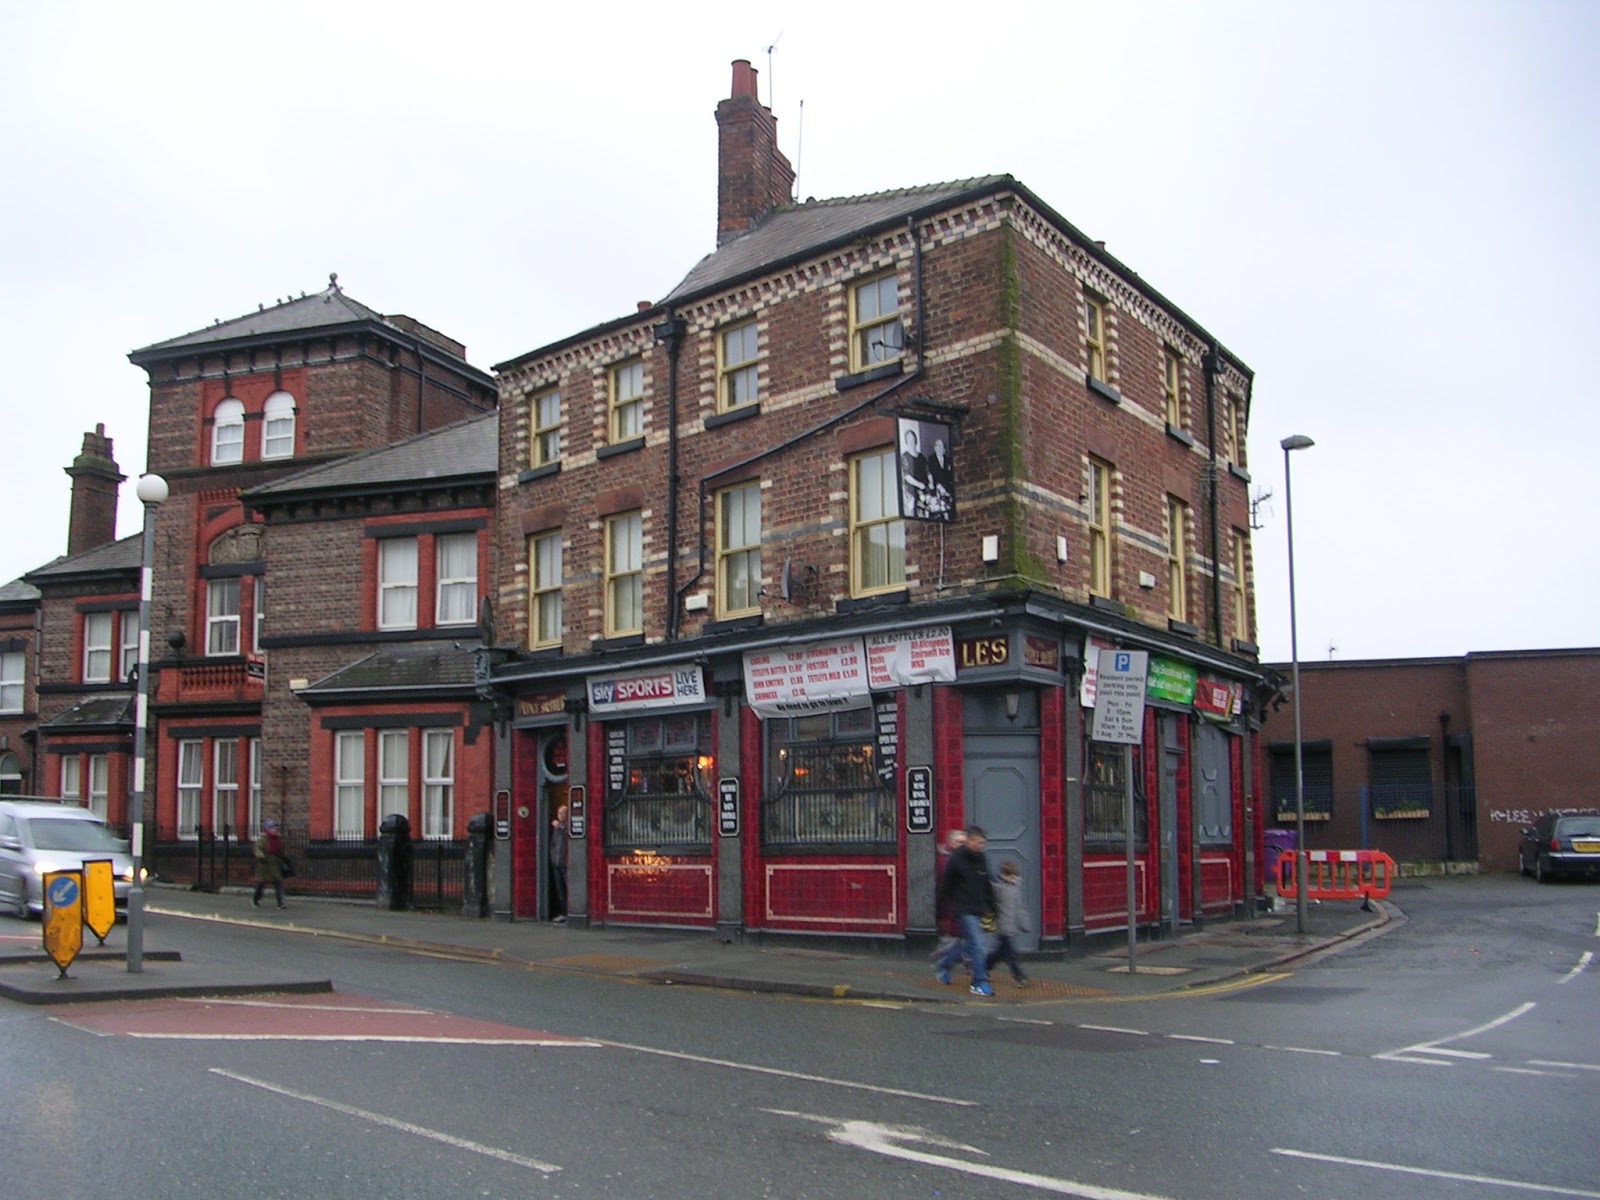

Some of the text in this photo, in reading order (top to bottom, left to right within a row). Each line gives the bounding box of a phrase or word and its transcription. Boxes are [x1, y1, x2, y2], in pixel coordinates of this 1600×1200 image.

[962, 638, 1007, 667] LES
[675, 670, 697, 685] LIVE
[617, 677, 673, 700] SPORTS
[677, 684, 699, 697] HERE
